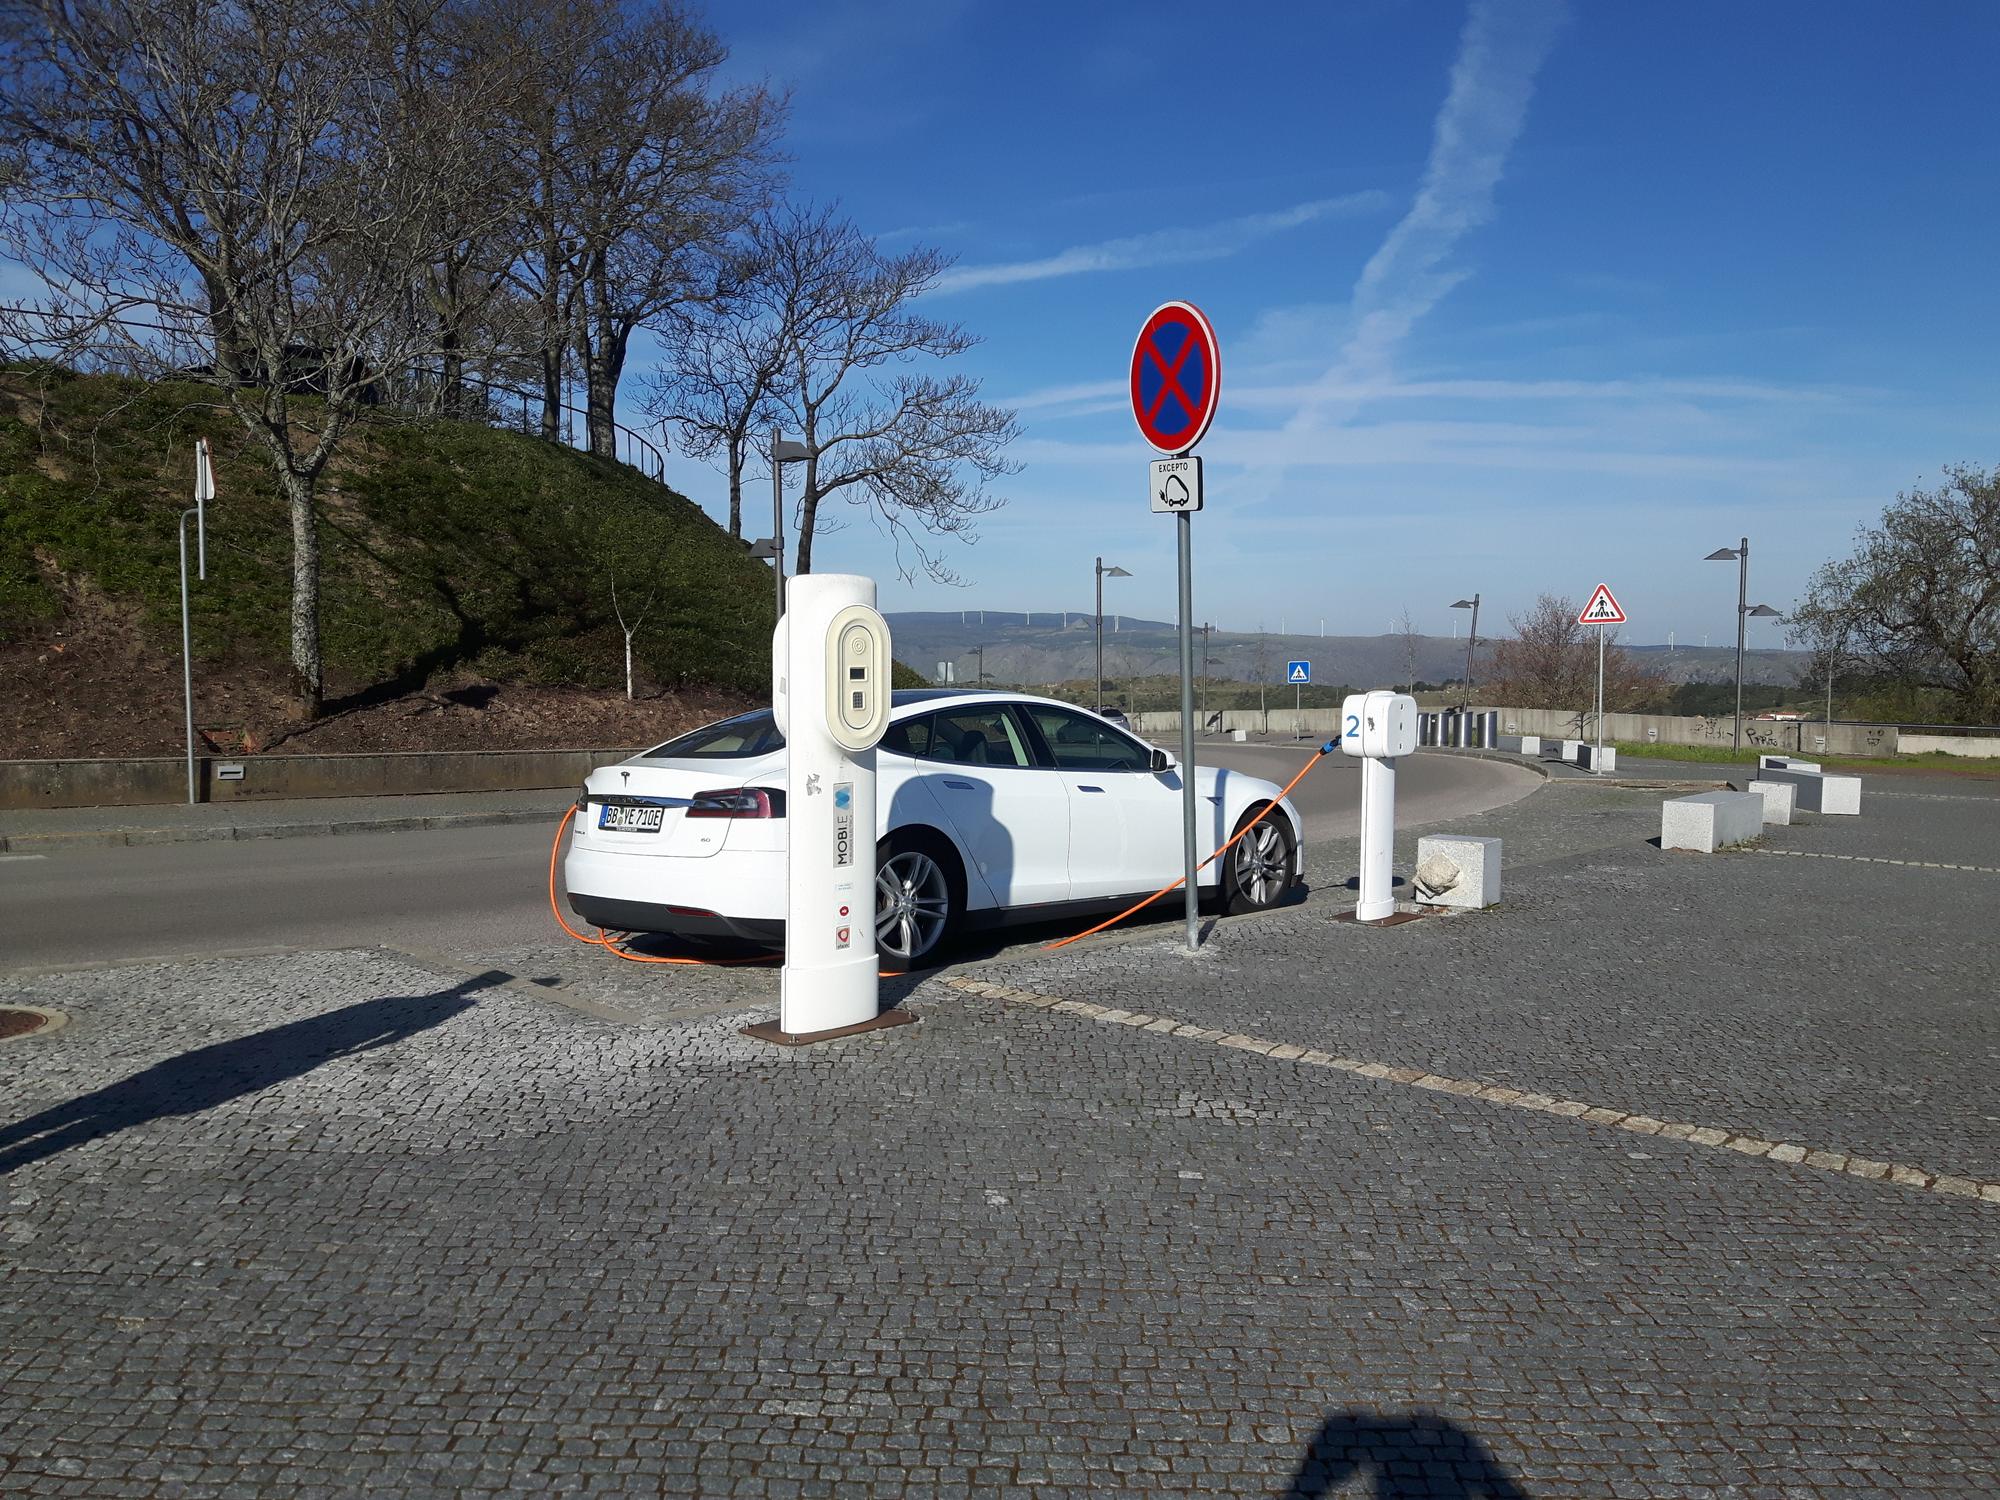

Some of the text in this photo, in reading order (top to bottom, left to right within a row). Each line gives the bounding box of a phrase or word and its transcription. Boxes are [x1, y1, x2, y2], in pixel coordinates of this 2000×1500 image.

[1158, 462, 1189, 473] EXCEPTO
[1346, 715, 1360, 738] 2
[606, 807, 661, 826] BB YE 710E
